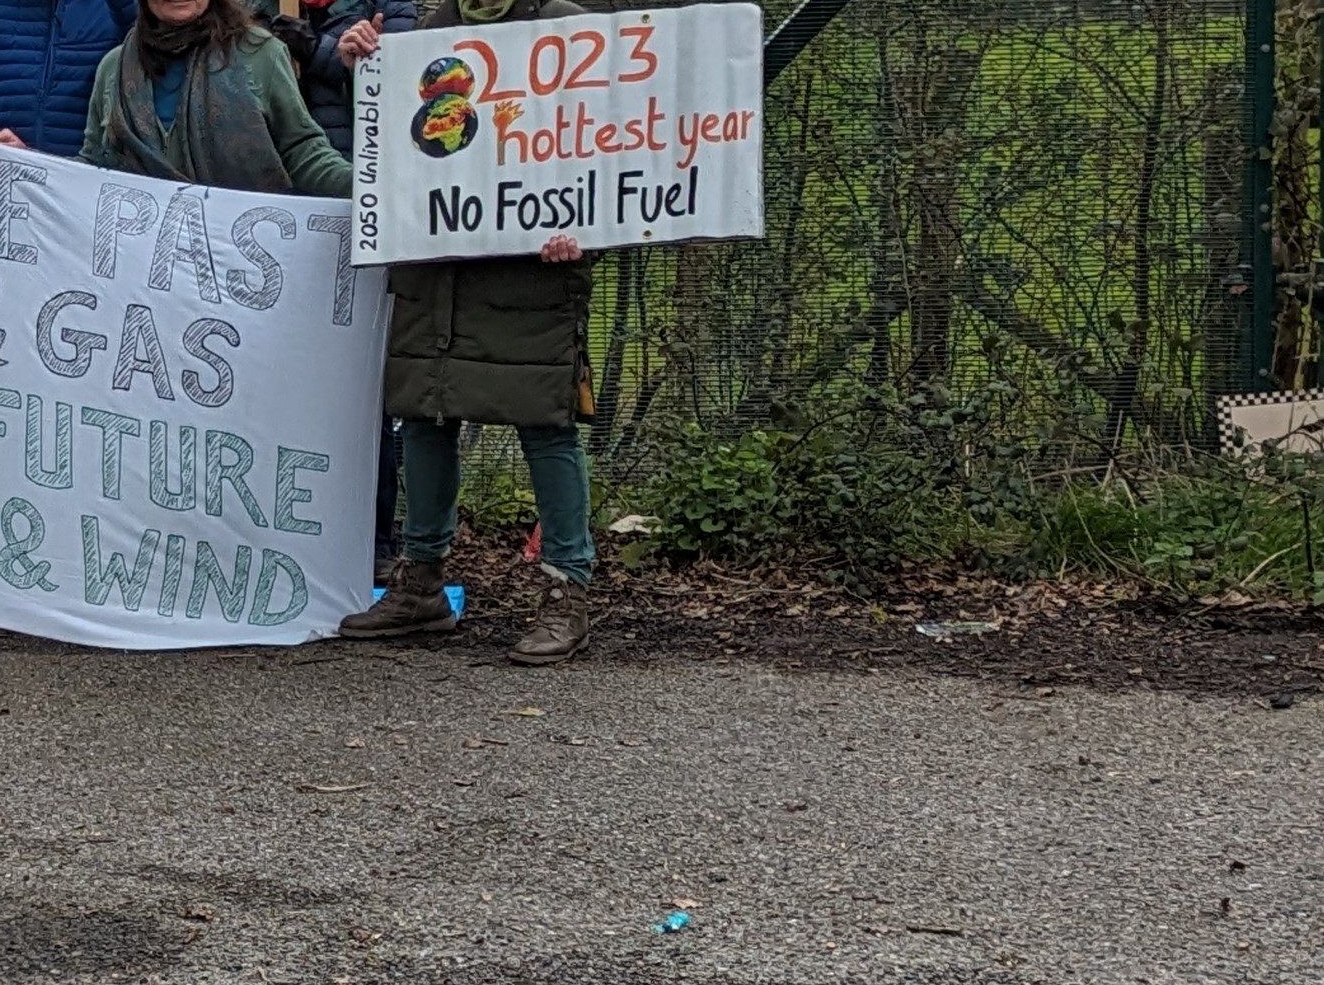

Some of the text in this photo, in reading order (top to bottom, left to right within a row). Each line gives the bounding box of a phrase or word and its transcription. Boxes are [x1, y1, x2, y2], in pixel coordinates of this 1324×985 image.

[453, 25, 658, 104] 2023
[357, 83, 381, 185] Unlivable
[494, 96, 755, 170] hottest year
[359, 193, 378, 251] 2050
[428, 165, 700, 236] No Fossil Fuel
[91, 181, 353, 327] PAST
[35, 289, 242, 408] GAS
[80, 514, 309, 627] WIND
